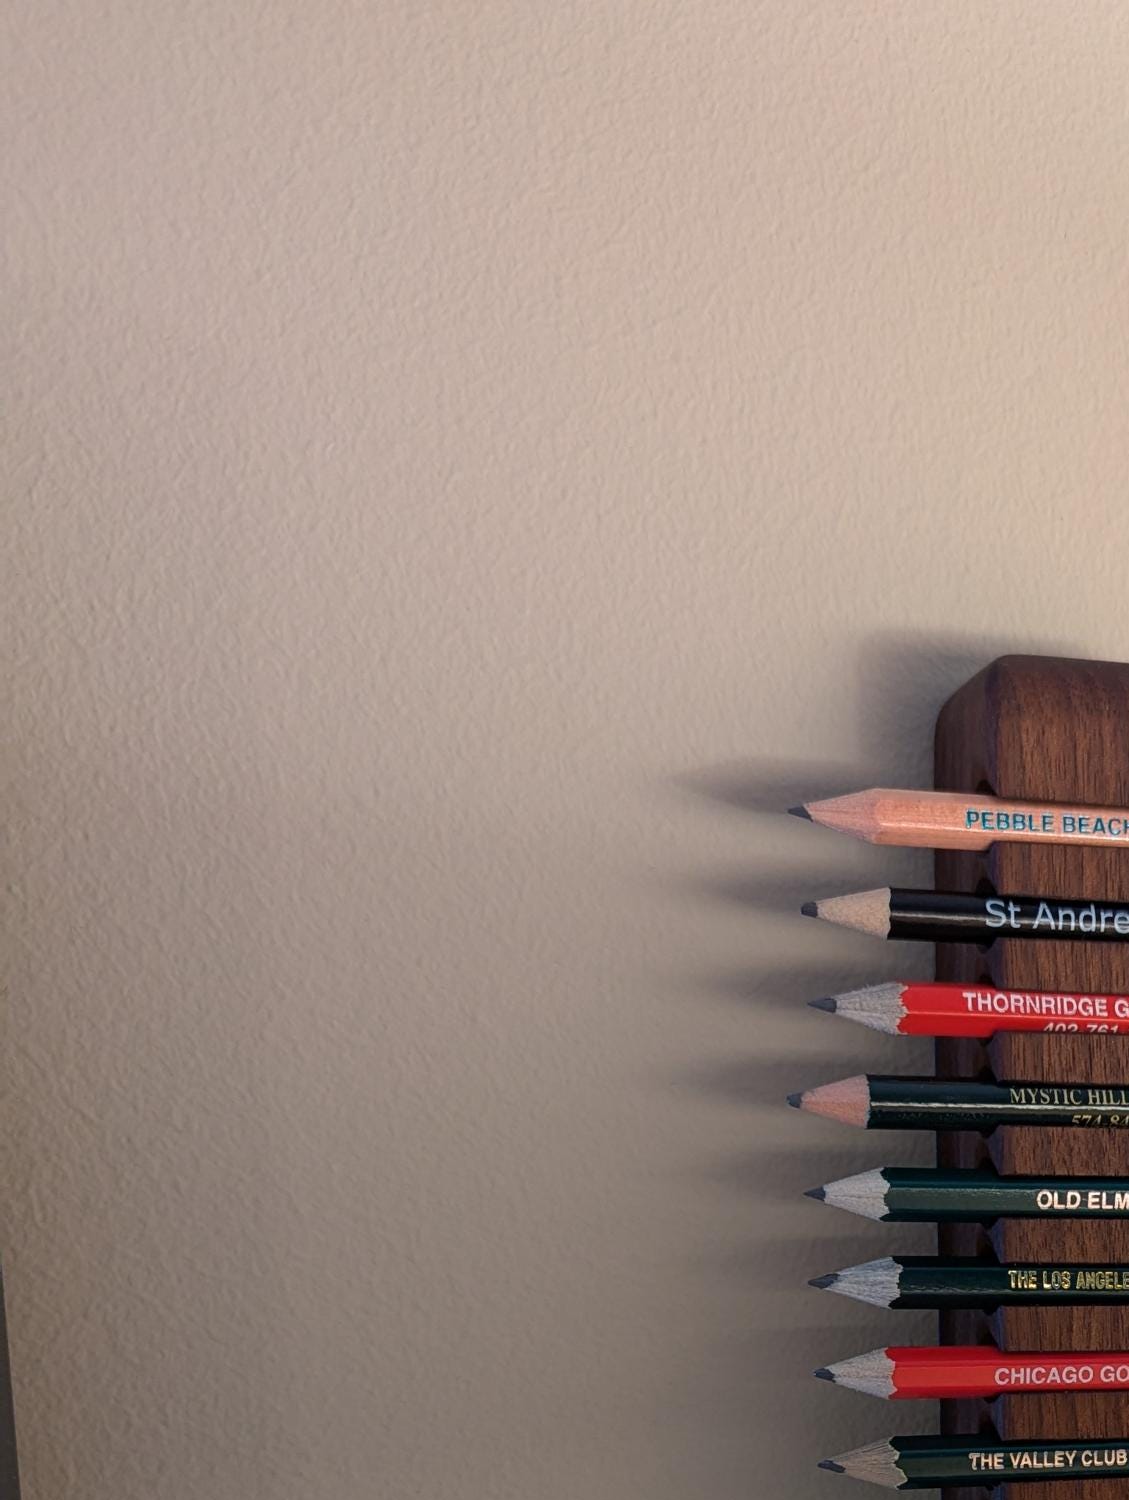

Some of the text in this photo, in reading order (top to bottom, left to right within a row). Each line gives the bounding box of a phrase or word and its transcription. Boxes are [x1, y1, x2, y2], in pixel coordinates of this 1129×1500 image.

[966, 808, 1054, 833] PEBBLE
[985, 899, 1021, 929] St
[962, 991, 1108, 1017] THORNRIDGE
[1009, 1087, 1083, 1106] MYSTIC
[1036, 1189, 1081, 1210] OLD
[1008, 1270, 1037, 1289] THE
[1043, 1270, 1071, 1290] LOS
[995, 1365, 1094, 1385] CHICAGO
[968, 1452, 1005, 1470] THE
[1010, 1450, 1077, 1469] VALLEY
[1081, 1448, 1127, 1466] CLUB
